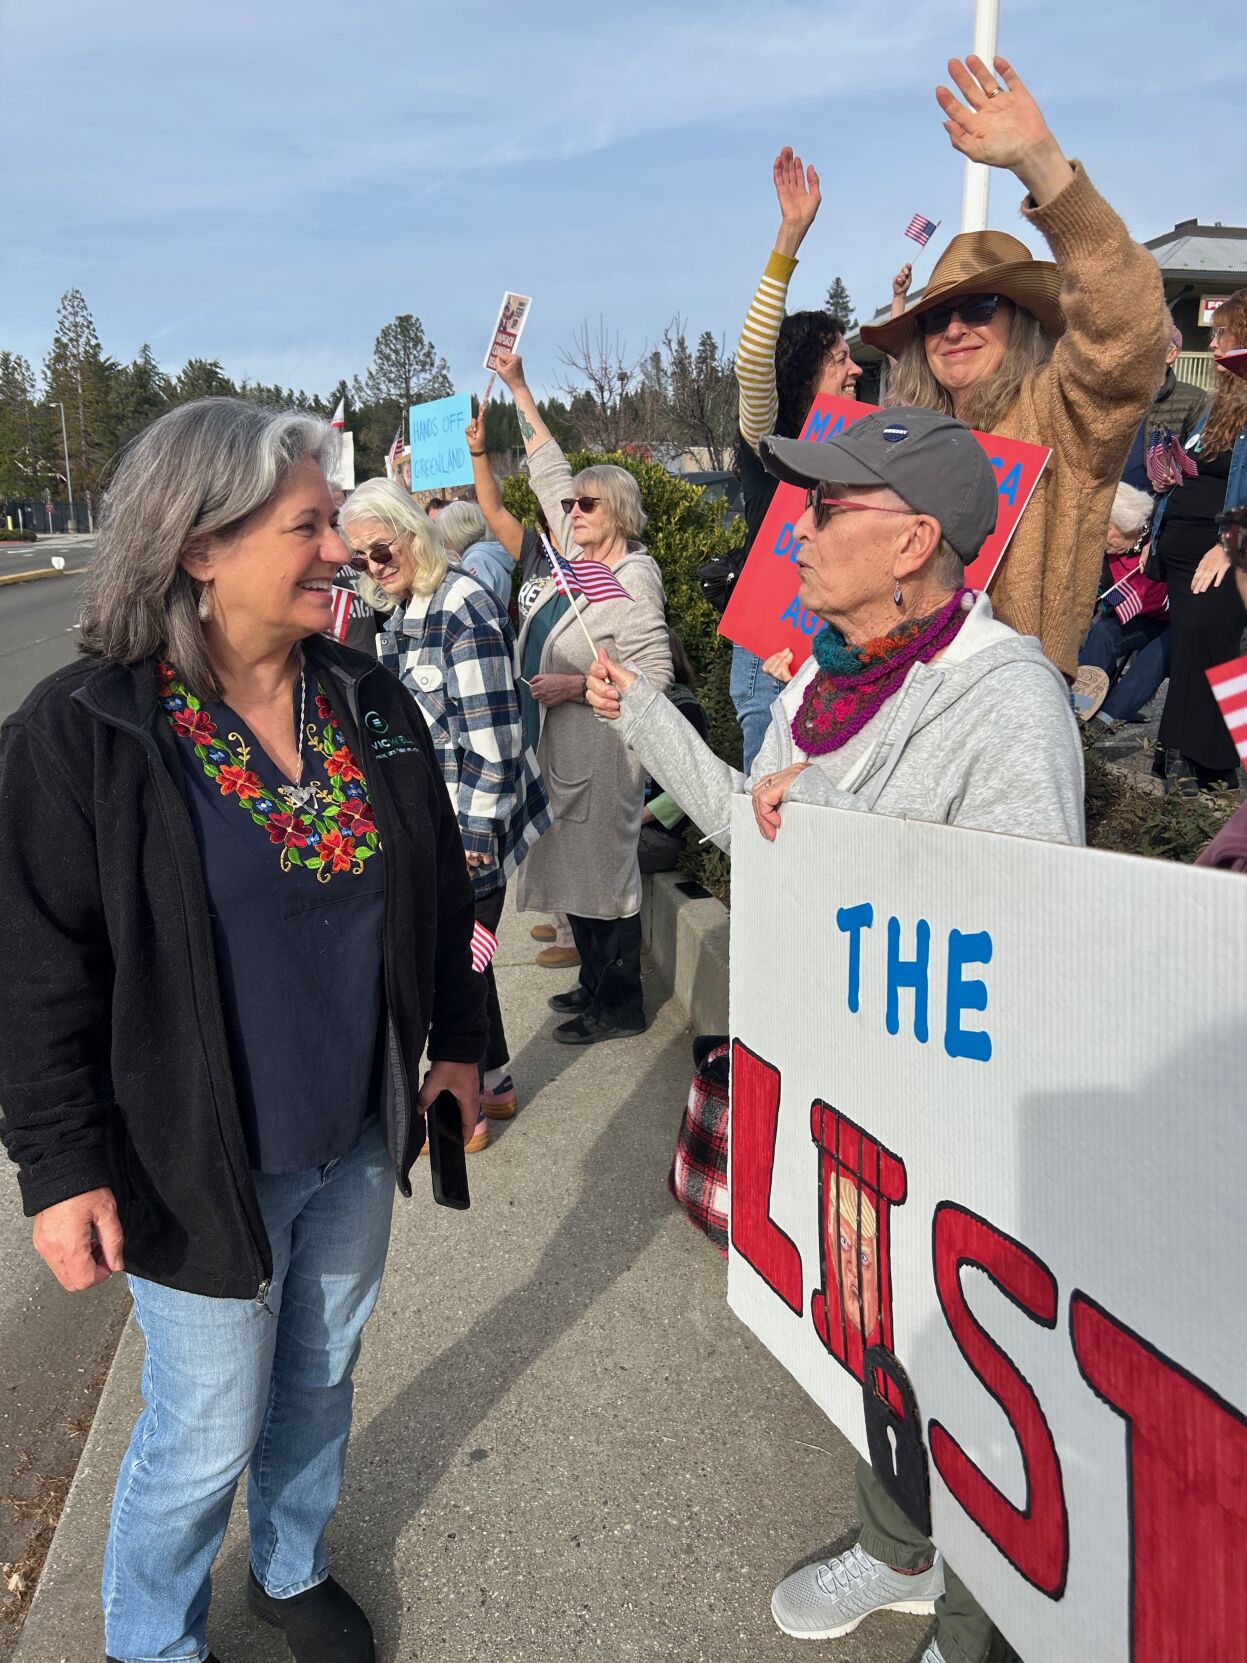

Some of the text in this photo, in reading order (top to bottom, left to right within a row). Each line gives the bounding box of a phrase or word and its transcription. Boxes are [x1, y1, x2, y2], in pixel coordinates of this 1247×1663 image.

[412, 411, 466, 444] HANDS OFF
[414, 447, 466, 480] GREENLAND
[836, 902, 993, 1062] THE
